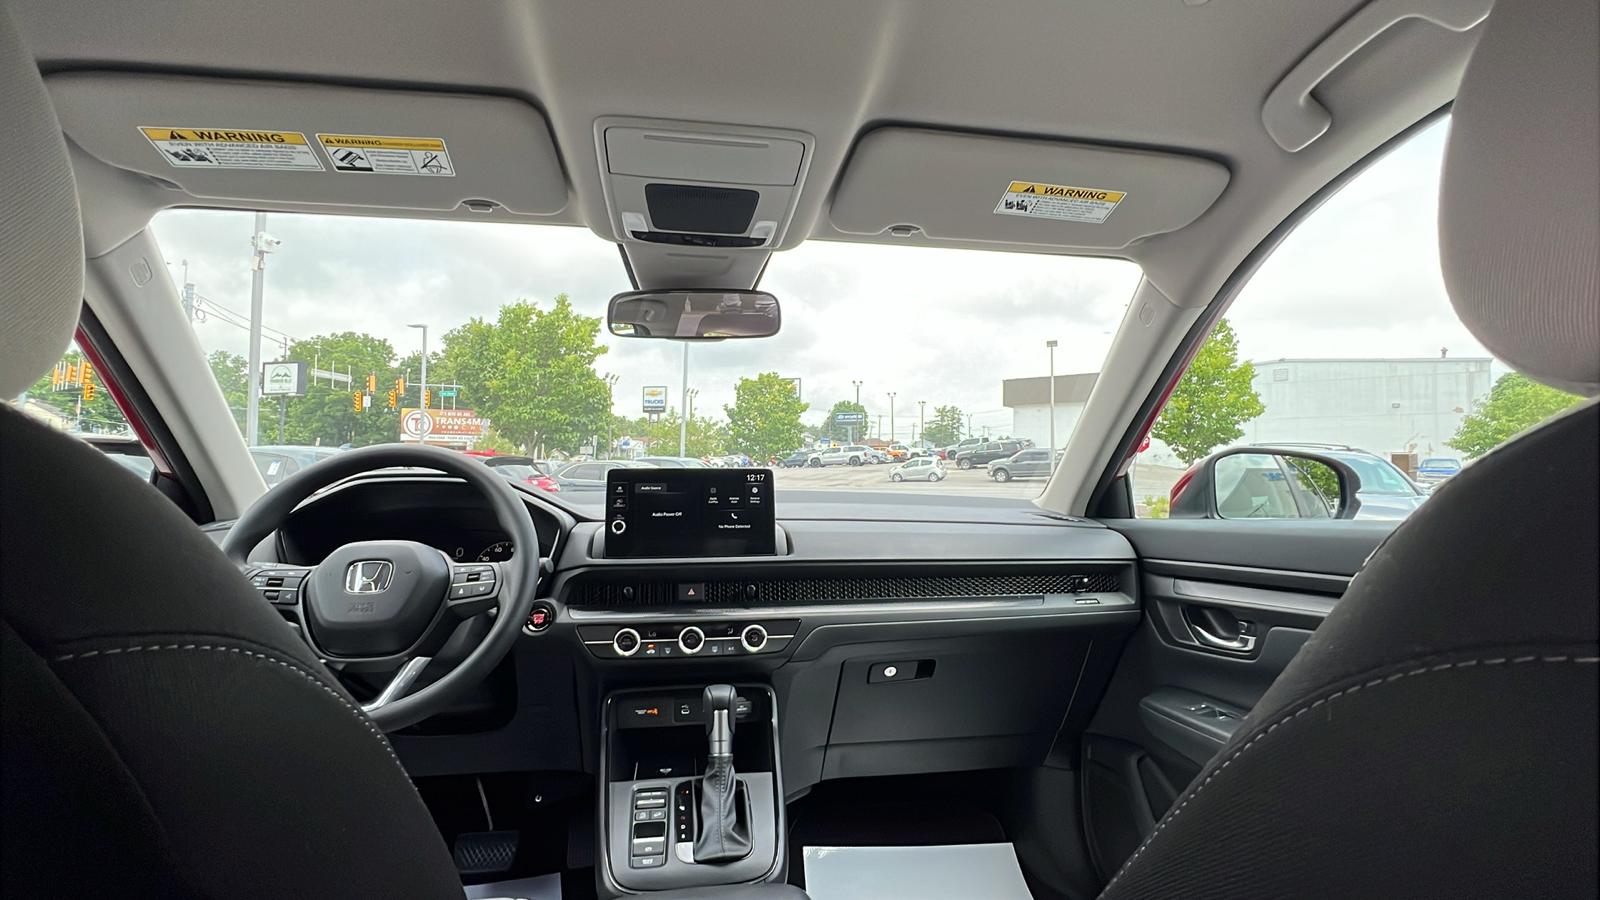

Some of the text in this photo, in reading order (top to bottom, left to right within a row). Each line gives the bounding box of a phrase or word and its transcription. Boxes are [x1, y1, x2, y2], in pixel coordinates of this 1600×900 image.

[192, 130, 286, 143] WARNING
[334, 138, 383, 146] WARNING
[1044, 186, 1108, 200] WARNING
[1048, 195, 1079, 203] ADVANCED
[746, 473, 765, 482] 12:17
